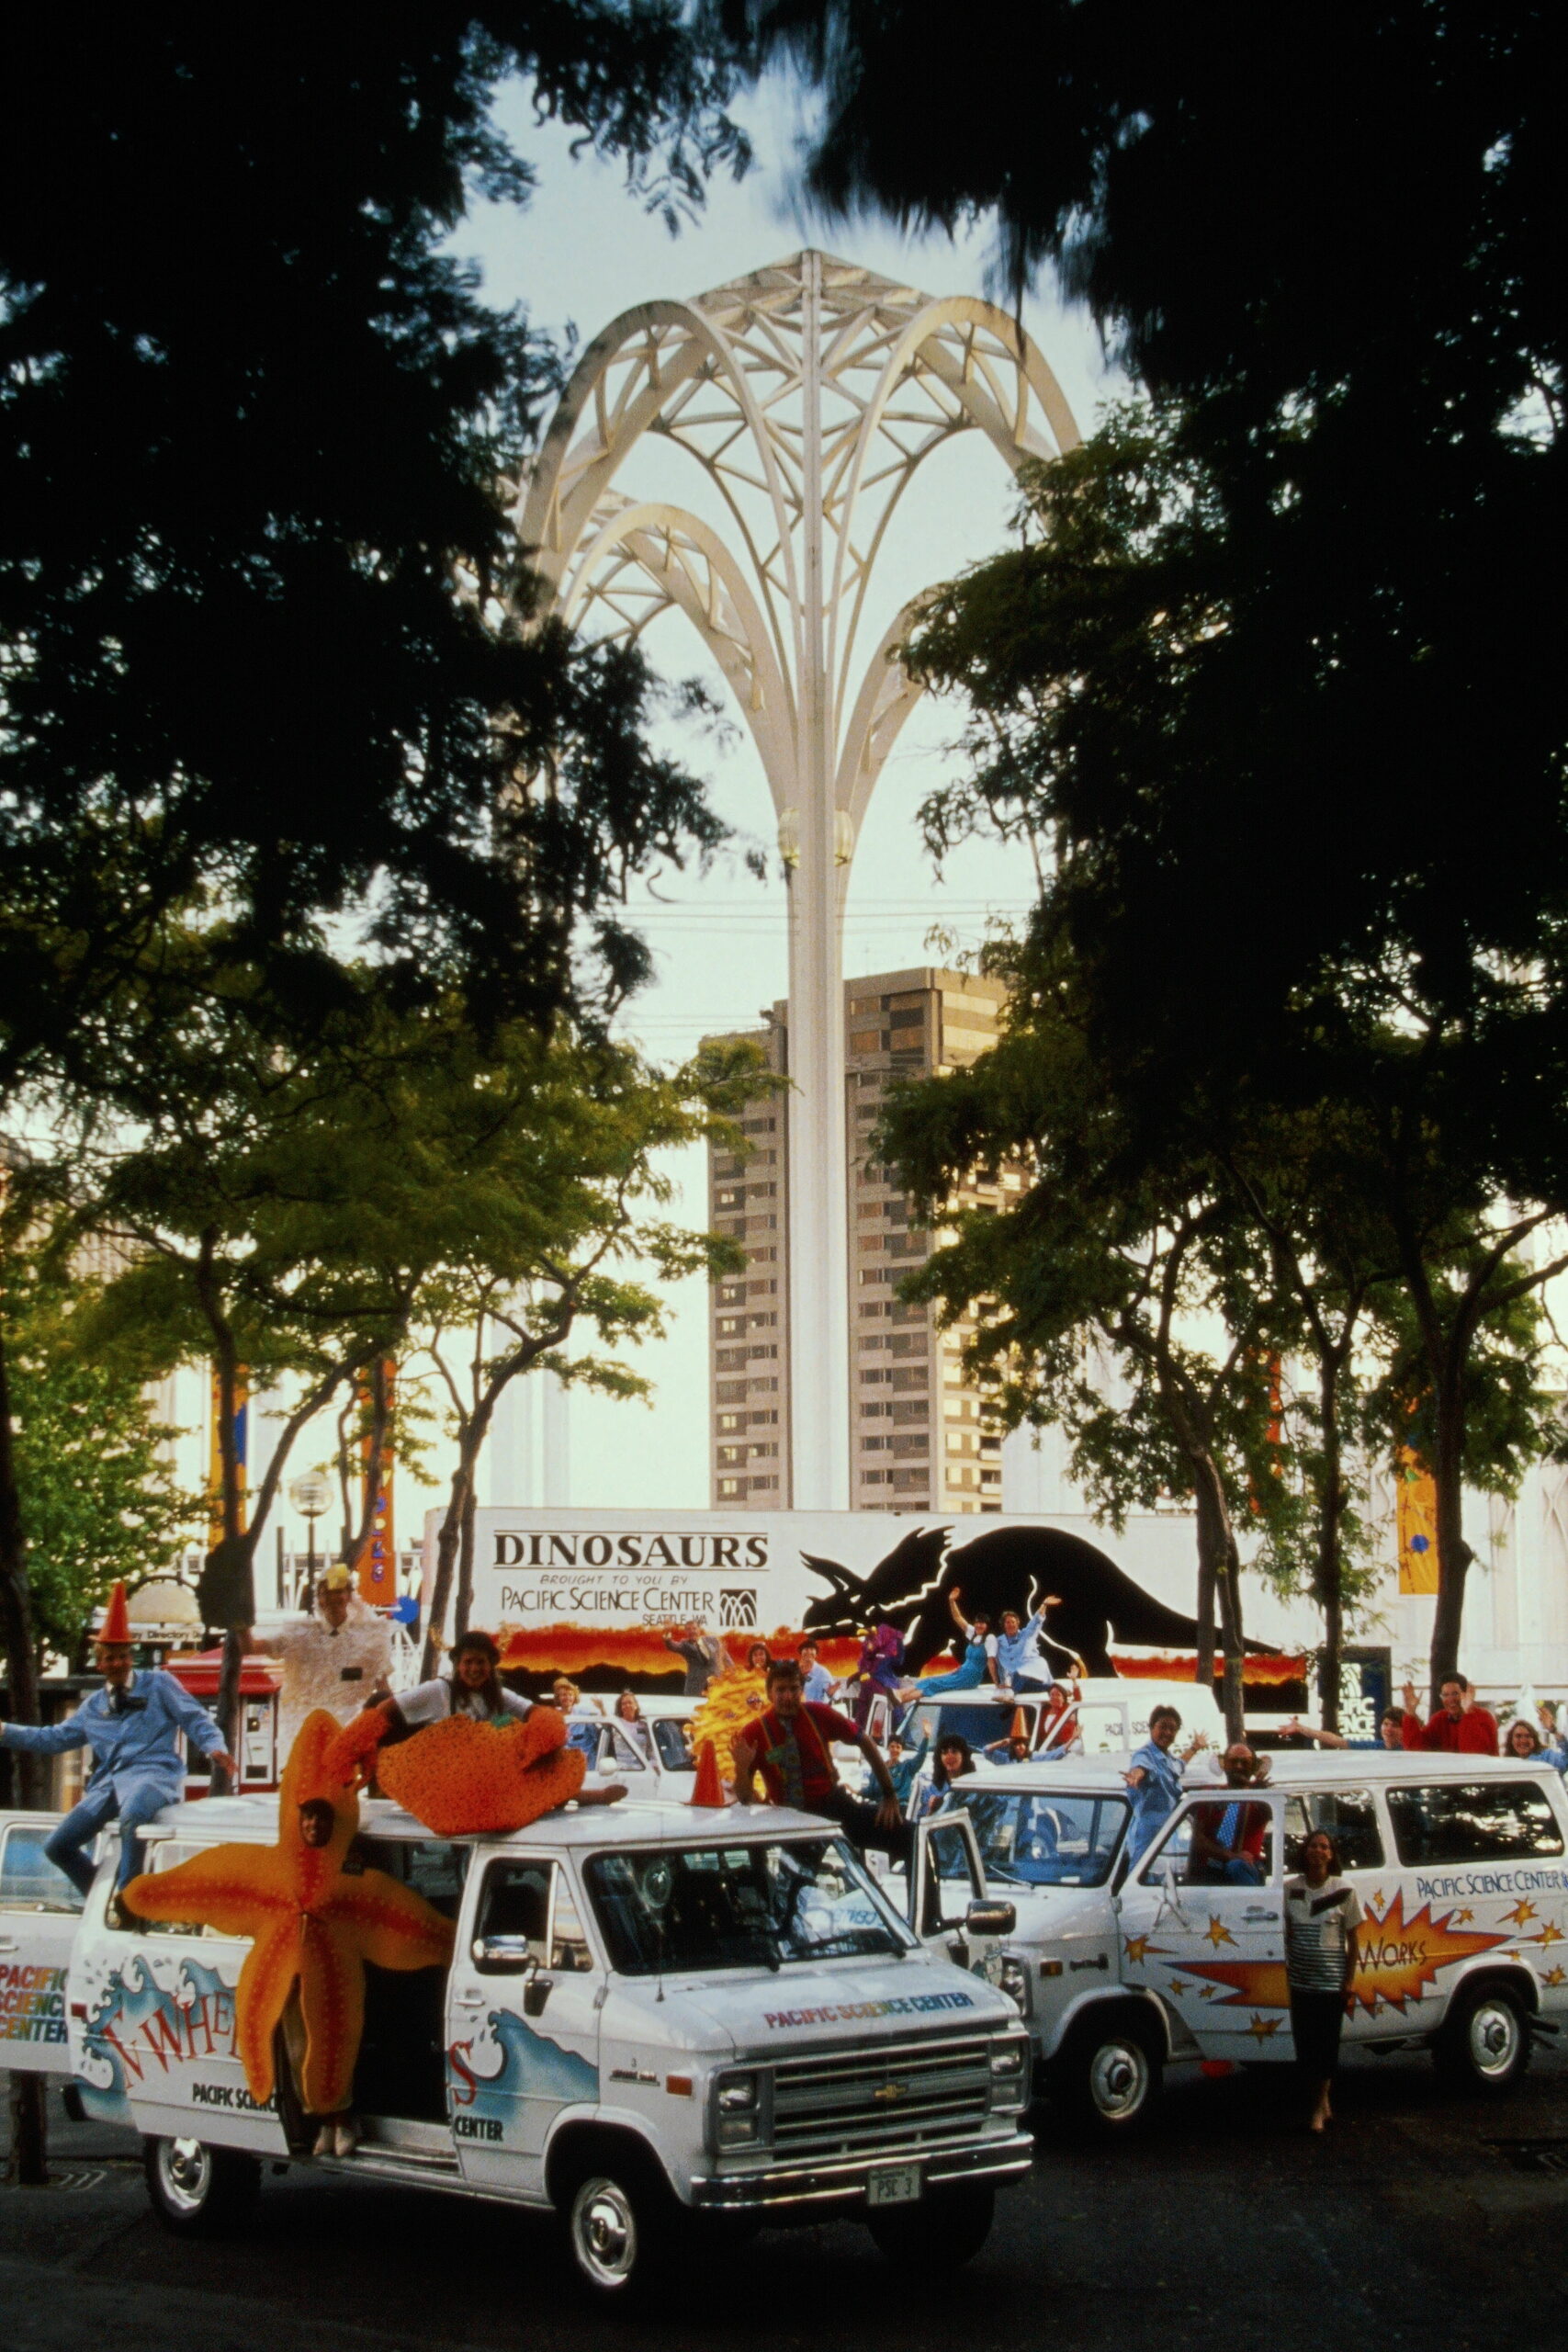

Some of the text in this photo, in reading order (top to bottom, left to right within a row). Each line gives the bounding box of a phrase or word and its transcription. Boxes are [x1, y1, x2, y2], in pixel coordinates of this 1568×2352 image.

[493, 1534, 768, 1567] DINOSAURS
[539, 1575, 689, 1587] BROUGHT TO YOU BY
[501, 1587, 716, 1613] PACIFIC SCIENCE CENTER
[1416, 1870, 1561, 1899] PACIFIC SCIENCE CENTER
[764, 1992, 975, 2029] PACIFIC SCIENCE CENTER
[192, 2082, 233, 2108] PACIFIC
[455, 2115, 503, 2142] CENTER
